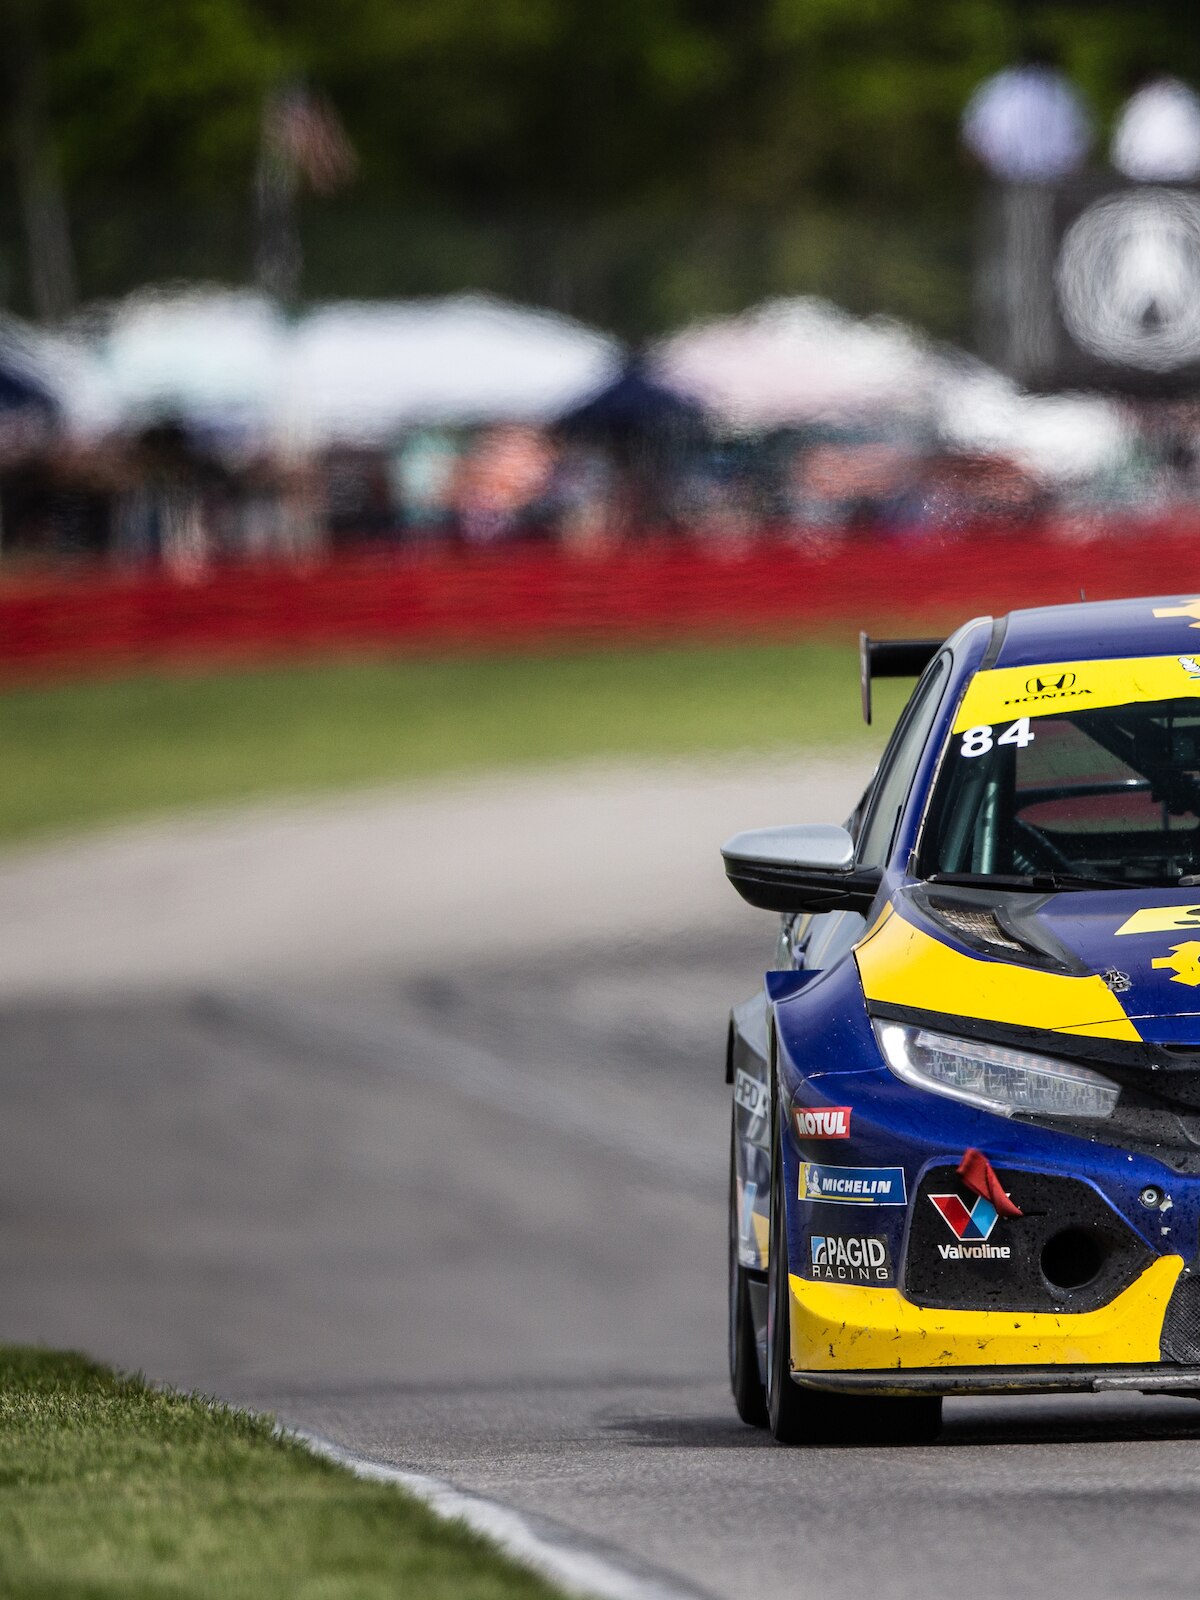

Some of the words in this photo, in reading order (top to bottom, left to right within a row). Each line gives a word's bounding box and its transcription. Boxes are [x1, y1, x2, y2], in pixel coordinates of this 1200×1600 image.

[1004, 688, 1093, 706] HONDA
[960, 717, 1035, 758] 84
[796, 1111, 847, 1136] MOTUL
[822, 1177, 892, 1194] MICHELIN
[826, 1236, 886, 1268] PAGID
[937, 1243, 1011, 1260] Valvoline
[811, 1267, 889, 1281] RACING
